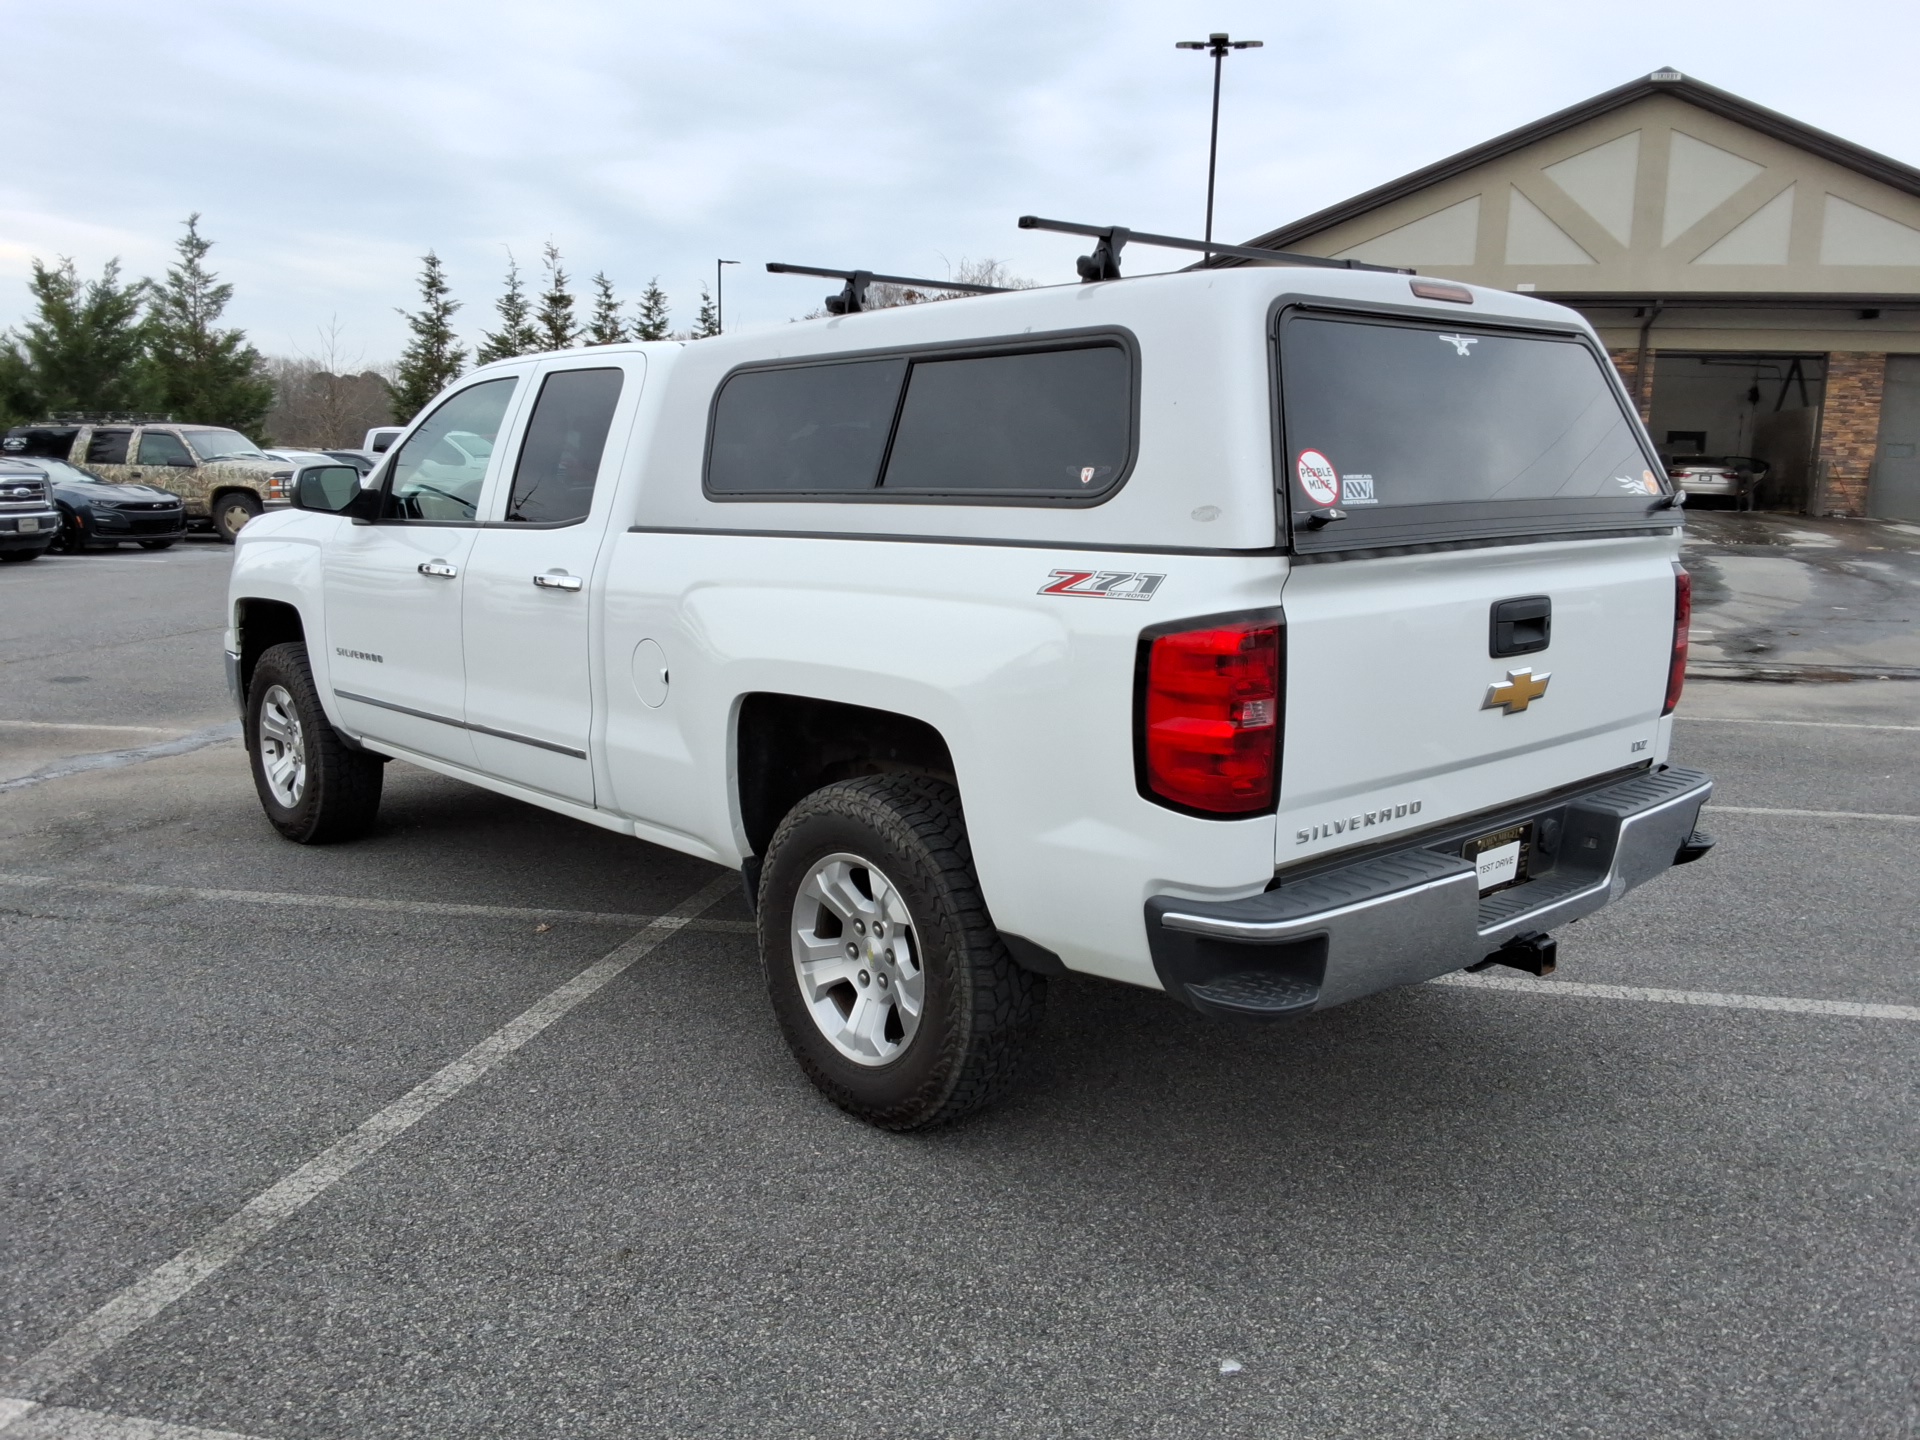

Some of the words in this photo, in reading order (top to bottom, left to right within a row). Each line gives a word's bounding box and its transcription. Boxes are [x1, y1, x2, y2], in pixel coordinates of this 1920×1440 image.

[1300, 467, 1332, 477] PEBBLE
[1037, 569, 1167, 599] Z71
[336, 647, 384, 663] SILVERADO
[1296, 800, 1422, 845] SILVERADO
[1479, 862, 1495, 874] TEST
[1495, 856, 1514, 869] DRIVE
